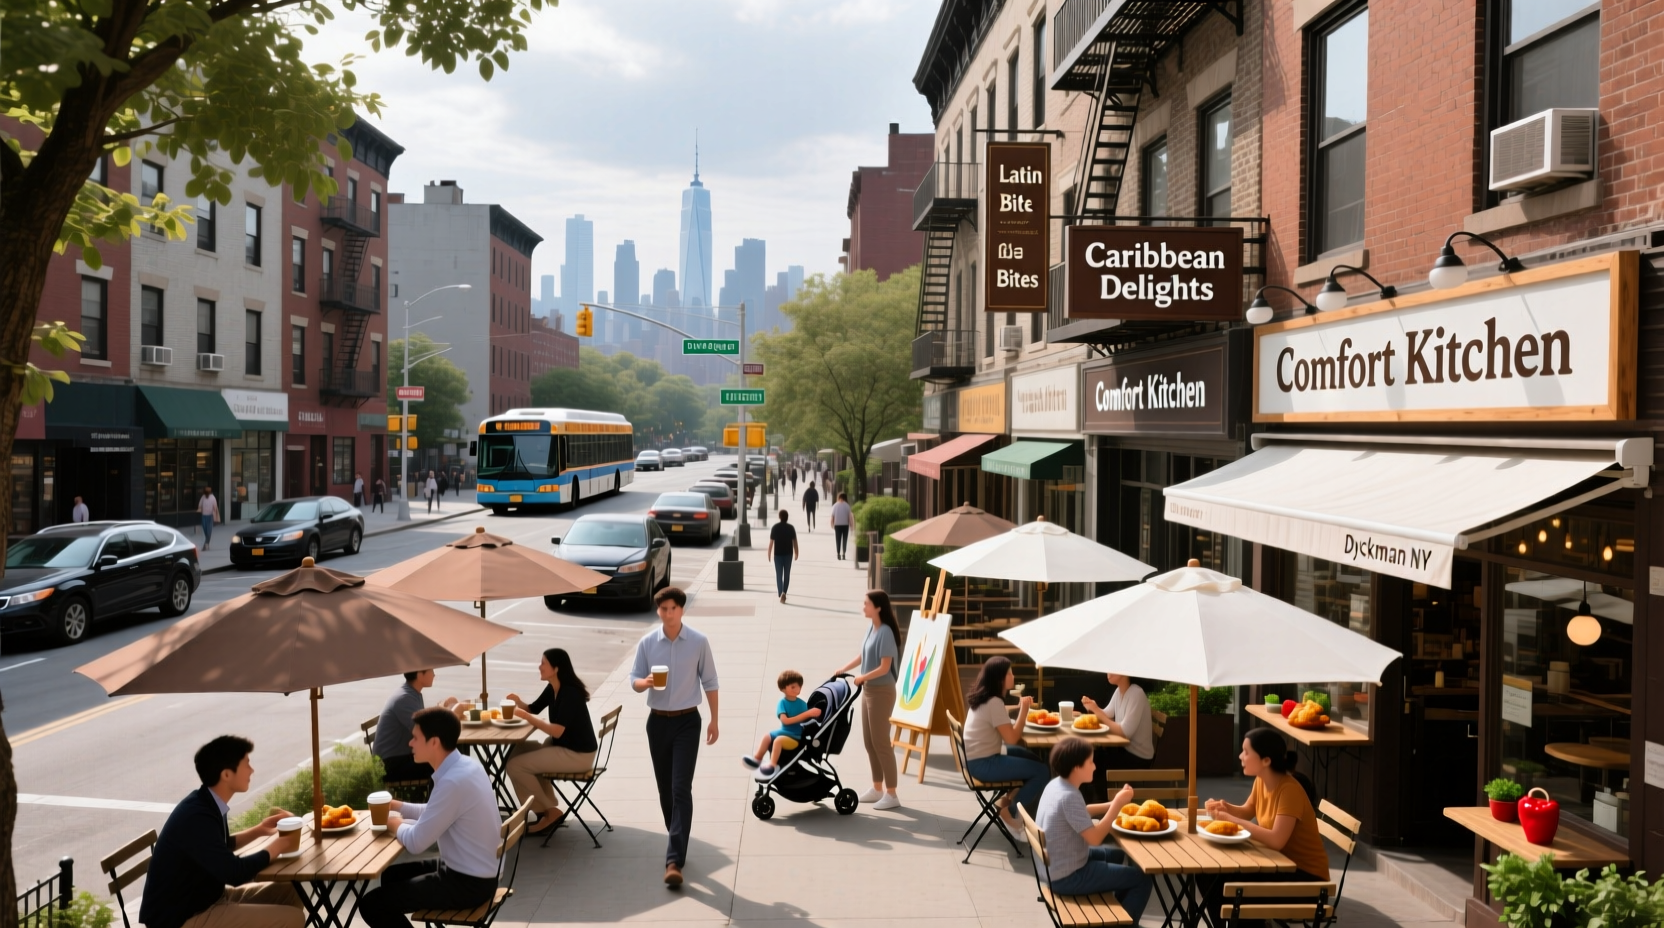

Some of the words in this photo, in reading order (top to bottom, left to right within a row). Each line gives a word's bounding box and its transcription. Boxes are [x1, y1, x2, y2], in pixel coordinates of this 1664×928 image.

[1000, 165, 1042, 184] Latin
[1000, 194, 1034, 212] Bite
[1085, 241, 1225, 269] Caribbean
[997, 269, 1039, 288] Bites
[1100, 274, 1214, 308] Delights
[1276, 337, 1396, 393] Comfort
[1404, 316, 1573, 385] Kitchen
[1095, 376, 1143, 412] Comfort
[1147, 371, 1206, 409] Kitchen
[1344, 533, 1406, 566] Dyckman
[1410, 548, 1432, 571] NY
